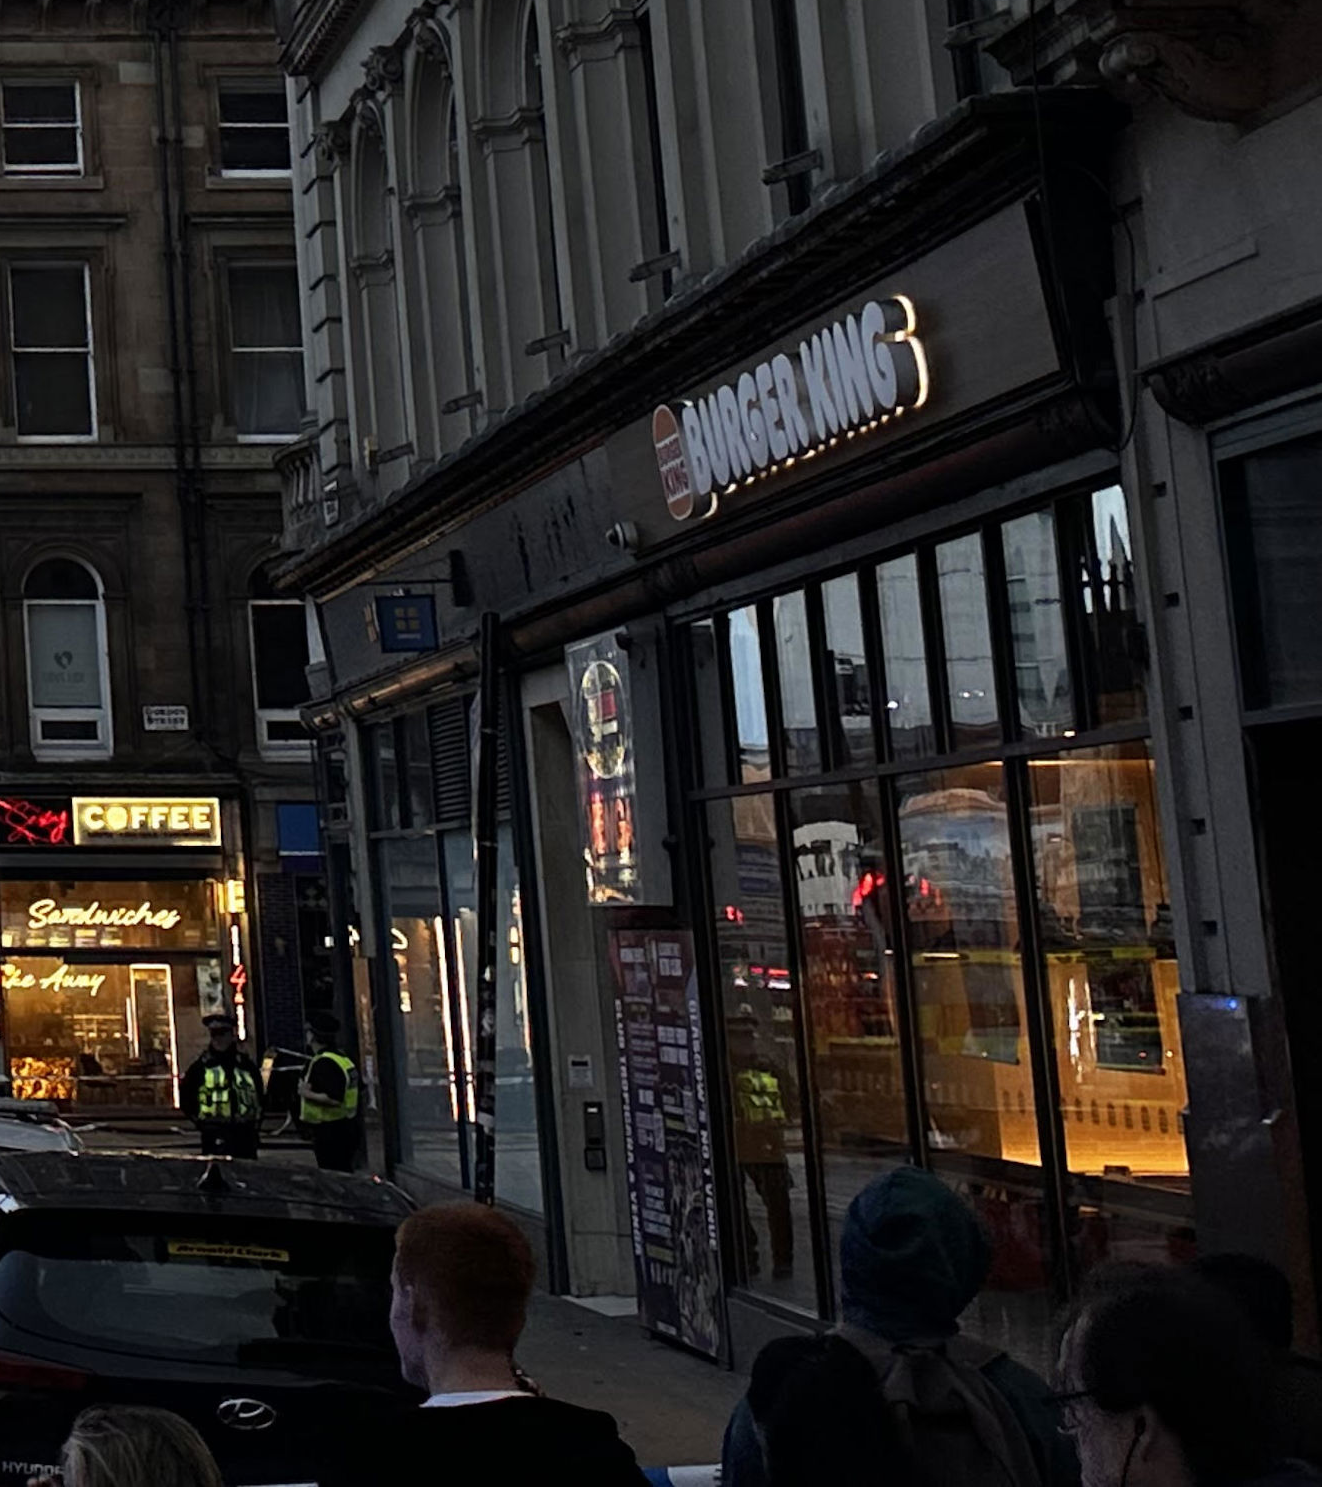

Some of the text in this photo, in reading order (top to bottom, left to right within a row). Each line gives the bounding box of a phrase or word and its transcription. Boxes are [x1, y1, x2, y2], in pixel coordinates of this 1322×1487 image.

[682, 301, 897, 496] BURGER KING
[84, 806, 211, 829] COFFEE
[28, 899, 181, 929] Sandwiches
[39, 964, 105, 996] Away
[614, 998, 626, 1050] CLUB
